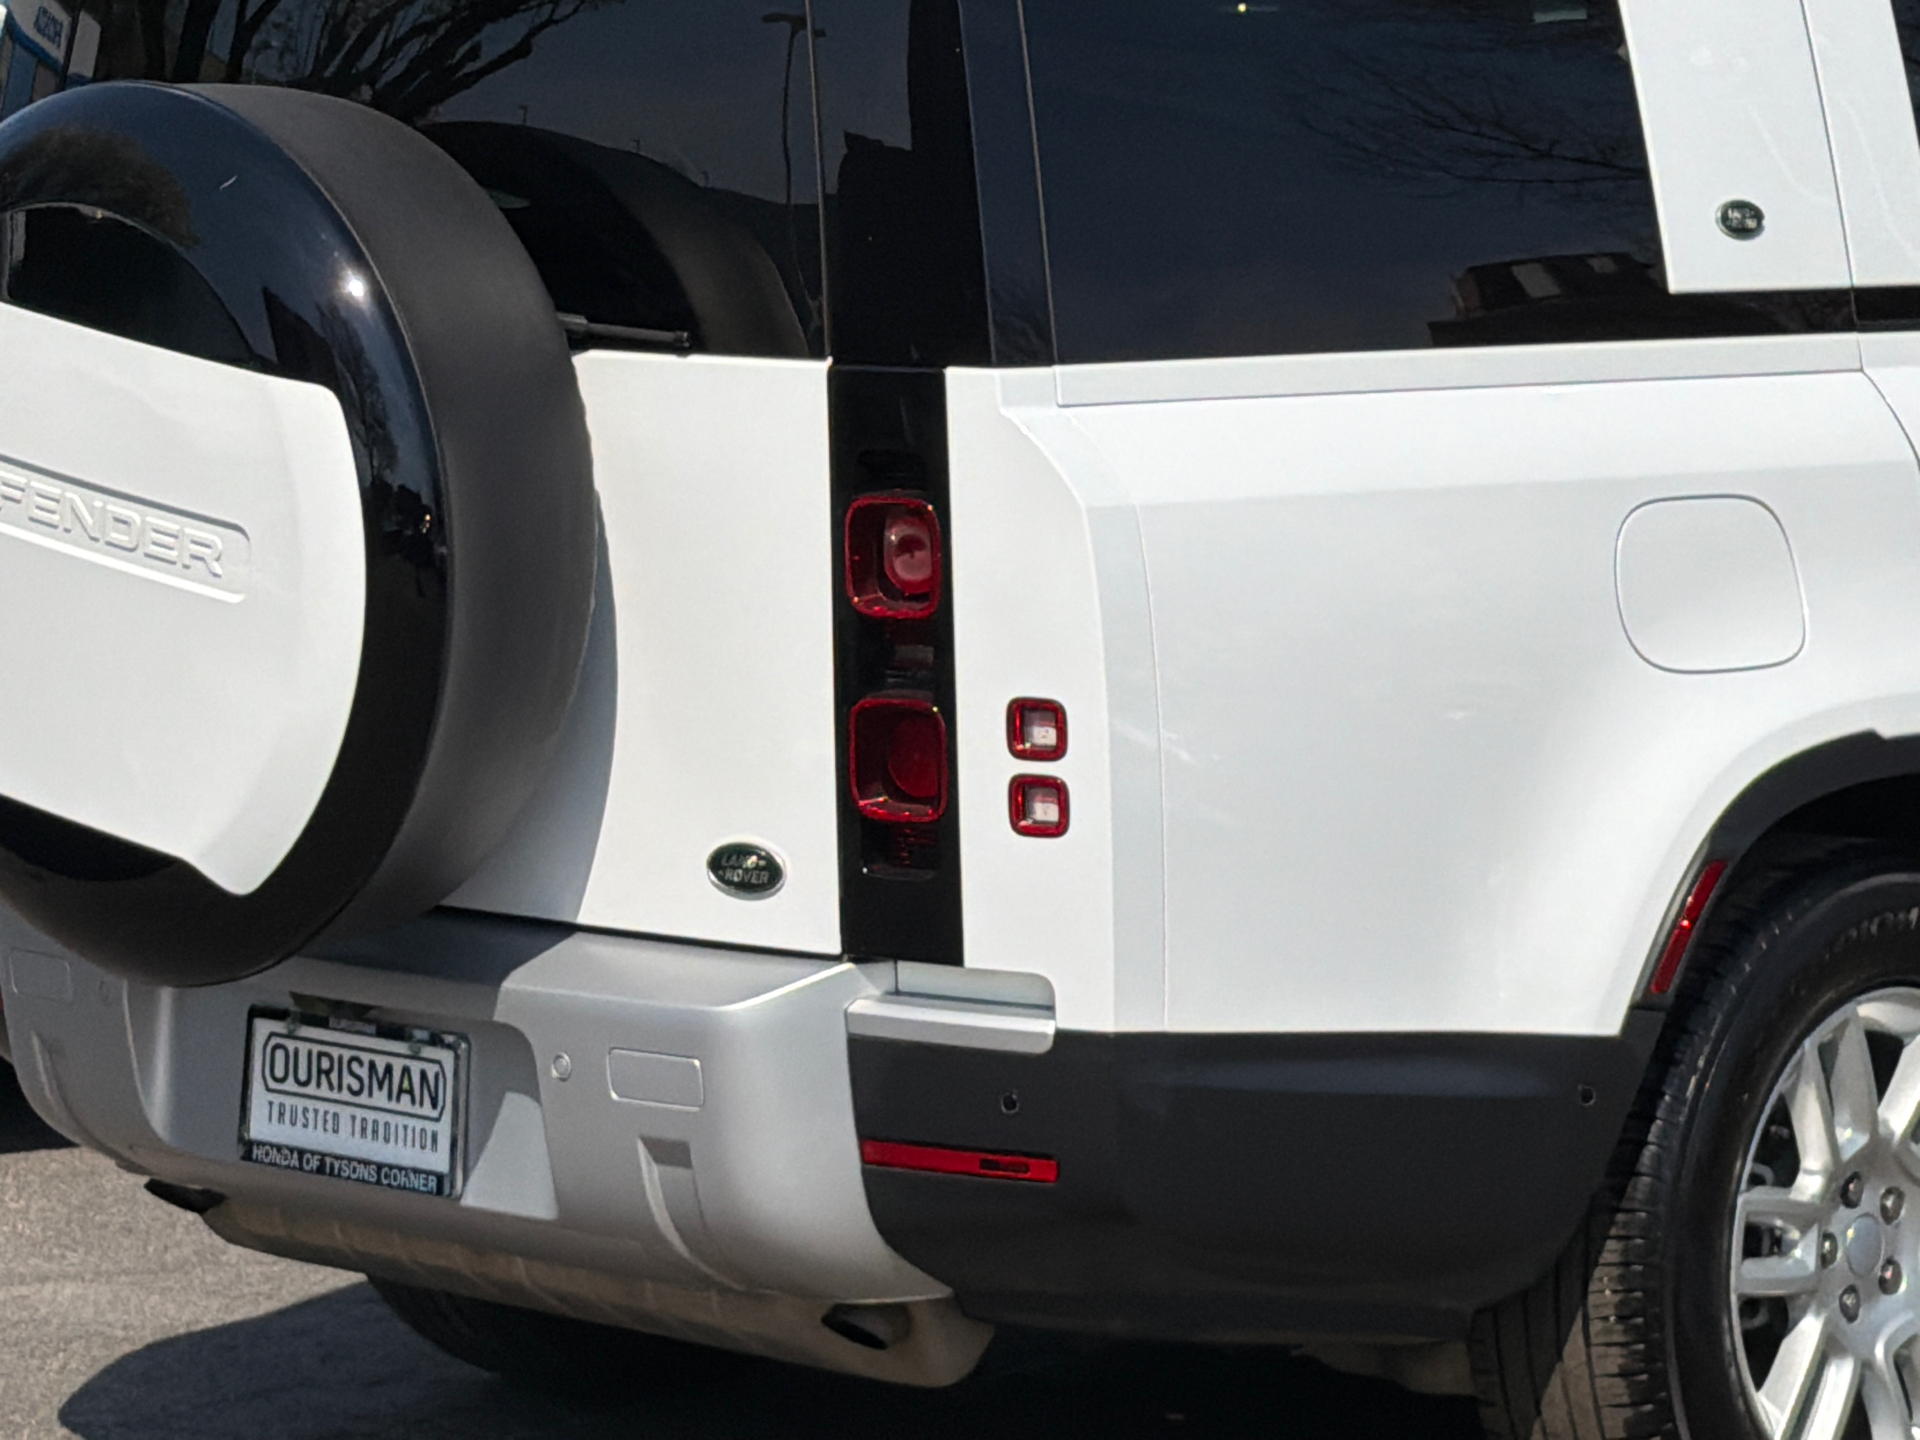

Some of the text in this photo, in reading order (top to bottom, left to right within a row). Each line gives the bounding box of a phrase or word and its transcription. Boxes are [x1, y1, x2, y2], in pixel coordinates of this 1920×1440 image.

[0, 470, 223, 578] FENDER
[724, 868, 769, 884] ROVER
[269, 1042, 440, 1110] OURISMAN
[267, 1100, 439, 1153] TRUSTED TRADITION
[252, 1145, 438, 1193] HONDA OF TYSONS CORNER
